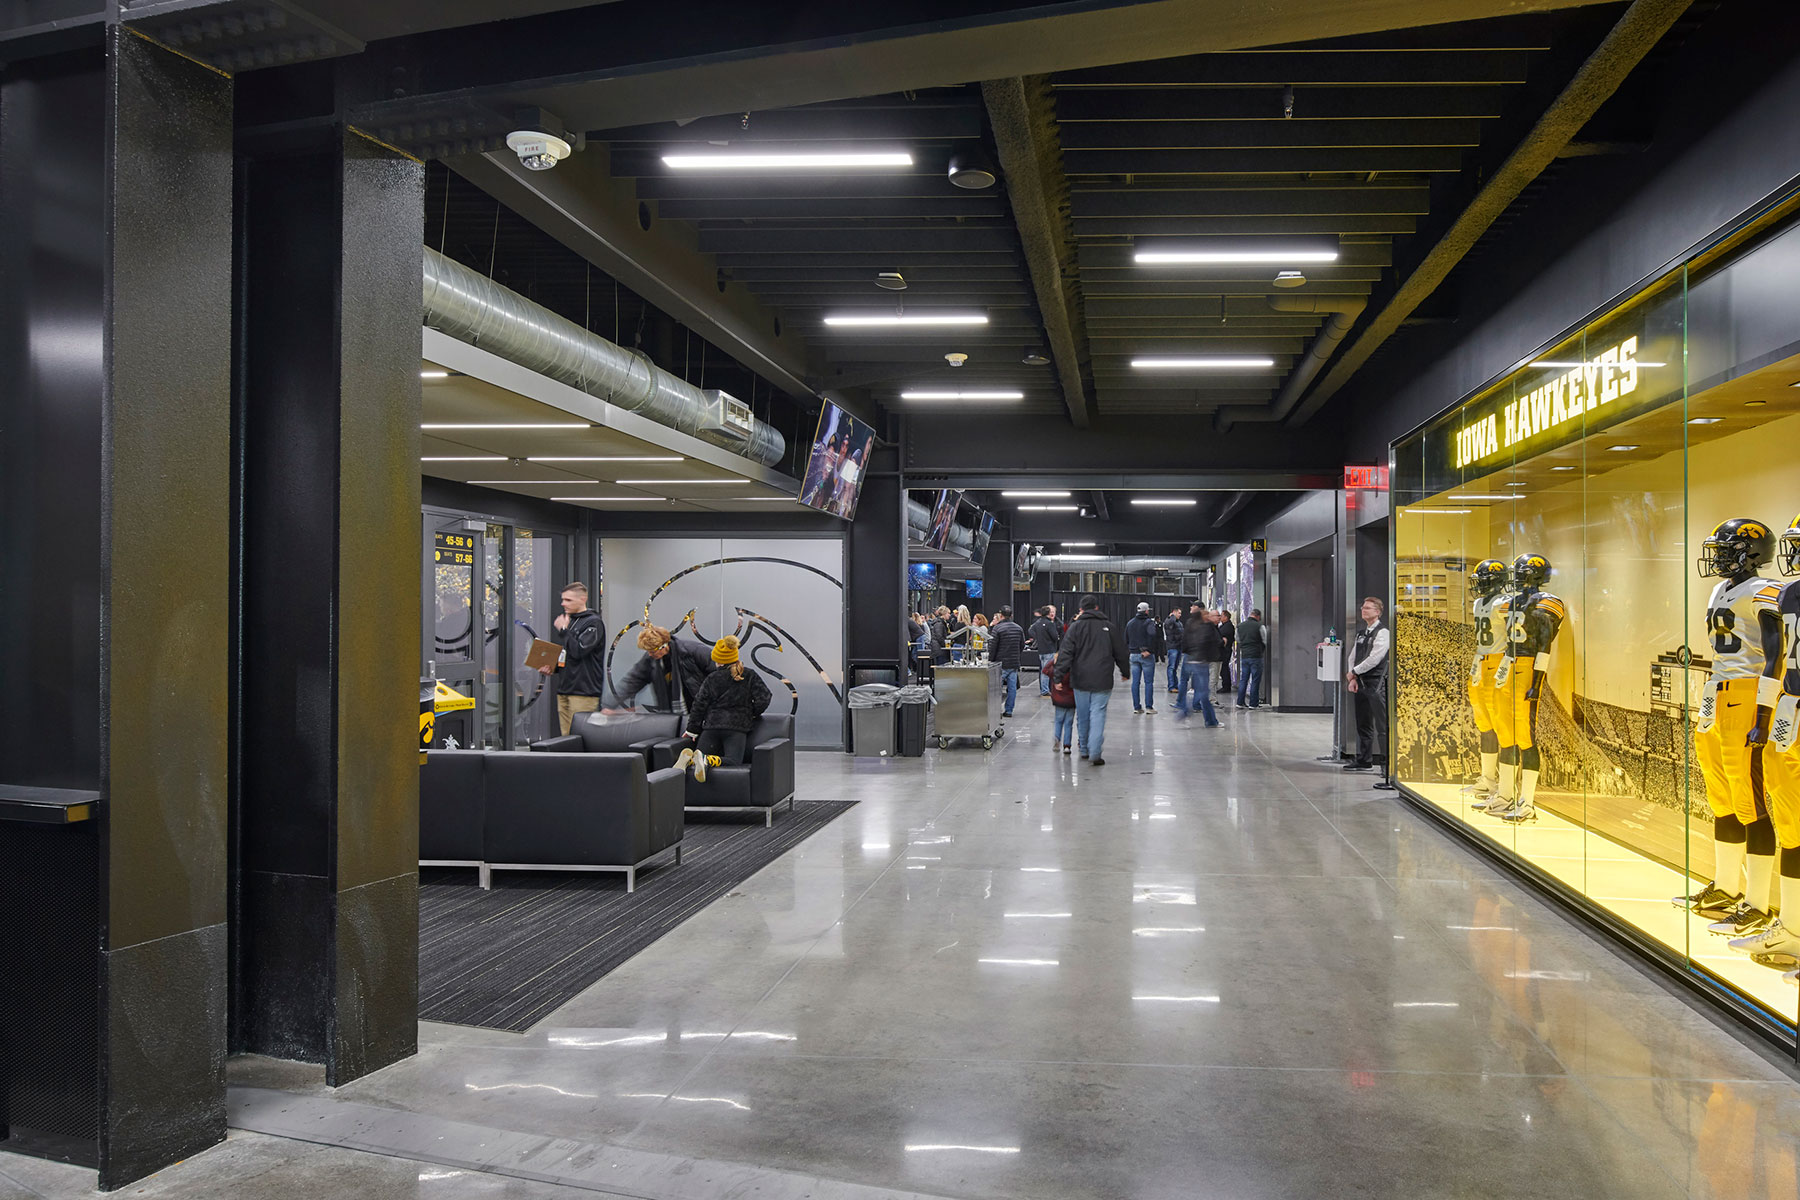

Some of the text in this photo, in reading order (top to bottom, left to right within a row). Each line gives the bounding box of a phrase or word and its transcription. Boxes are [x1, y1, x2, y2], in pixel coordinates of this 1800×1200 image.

[1456, 335, 1638, 469] IOWA HAWKEYES
[1351, 468, 1372, 485] EXIT
